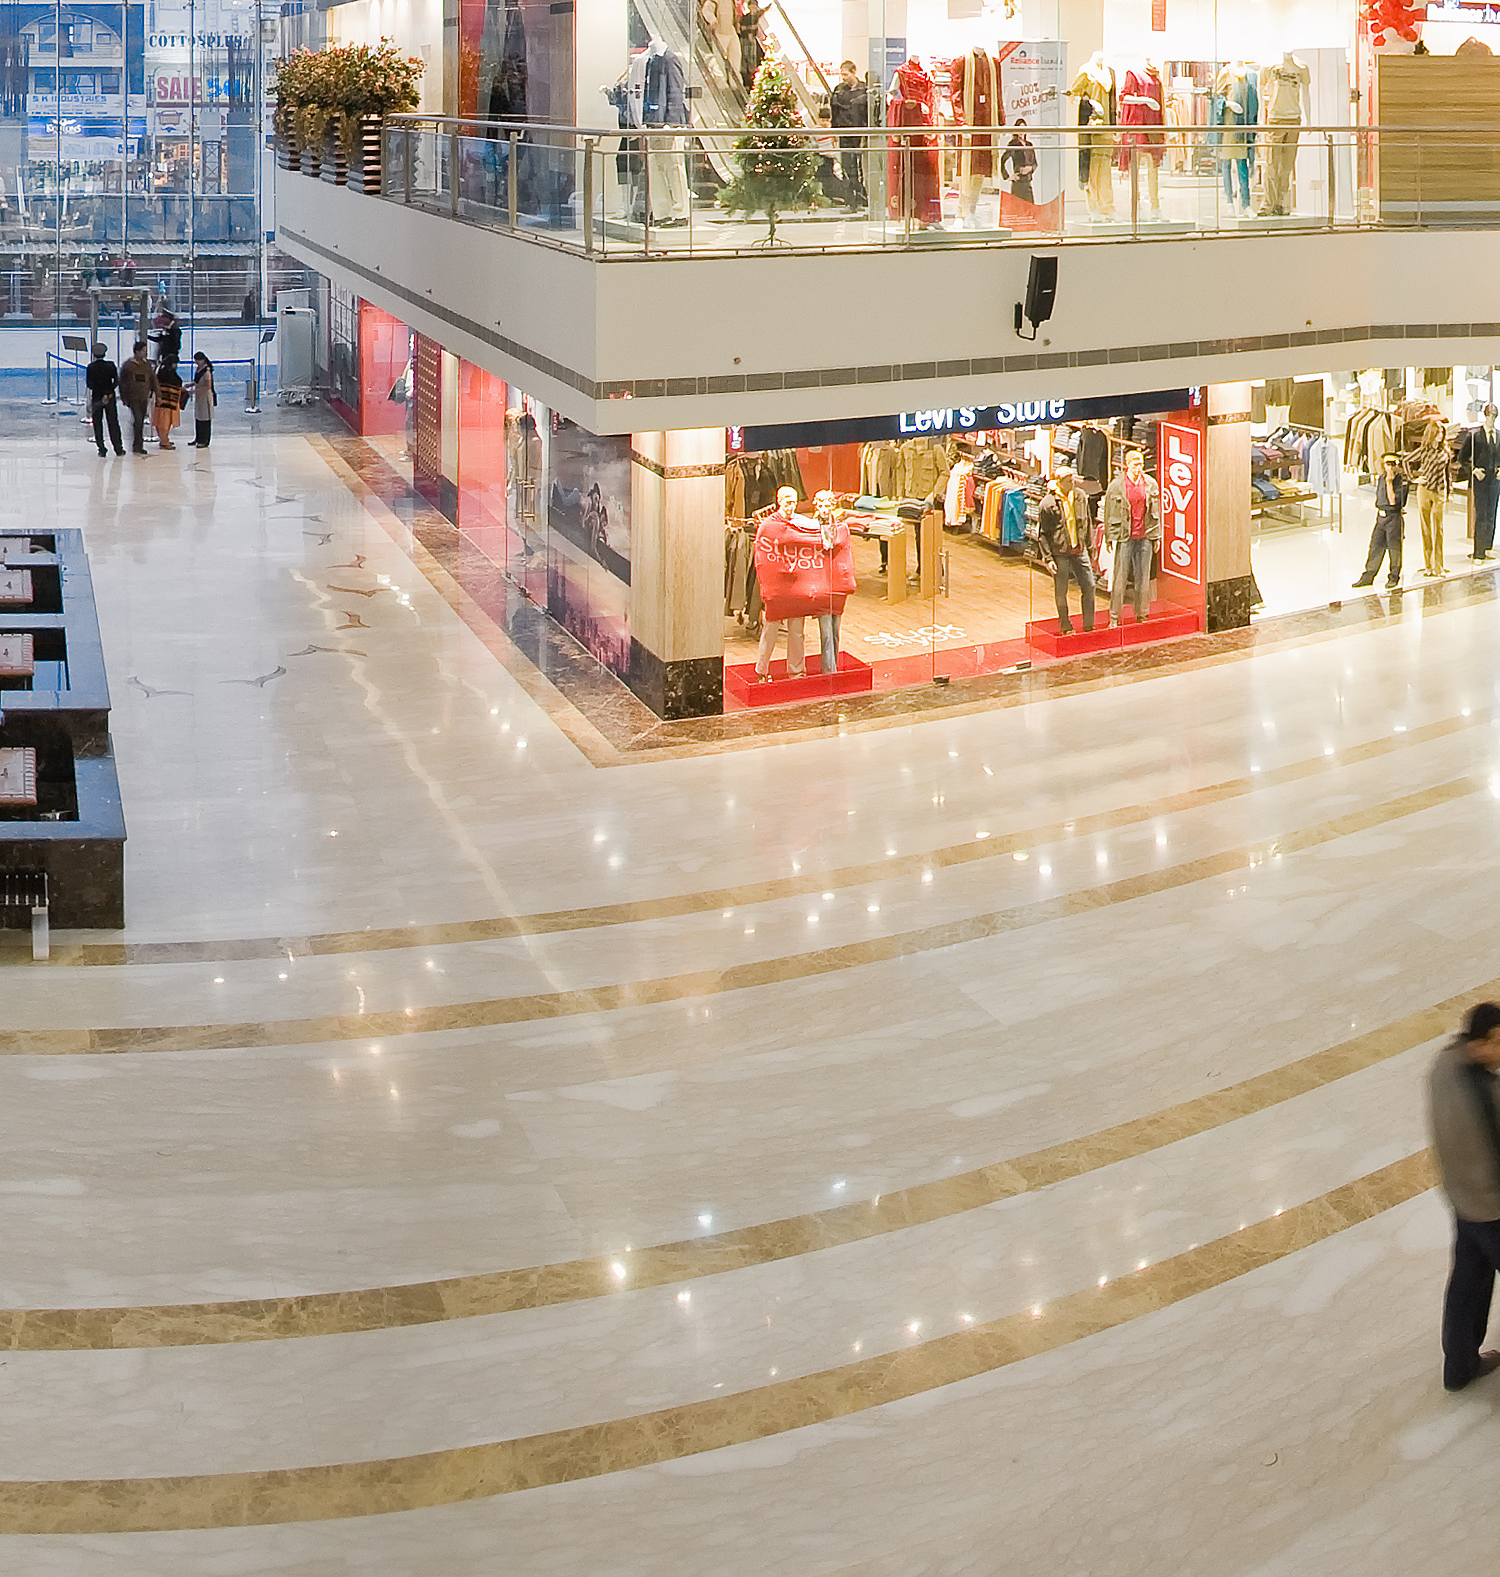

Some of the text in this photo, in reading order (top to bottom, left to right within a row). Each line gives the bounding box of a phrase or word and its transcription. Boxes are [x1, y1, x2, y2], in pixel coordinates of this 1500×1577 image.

[157, 77, 203, 100] SALE
[1020, 82, 1040, 96] 100%
[1011, 96, 1031, 110] CASH
[786, 556, 824, 572] you
